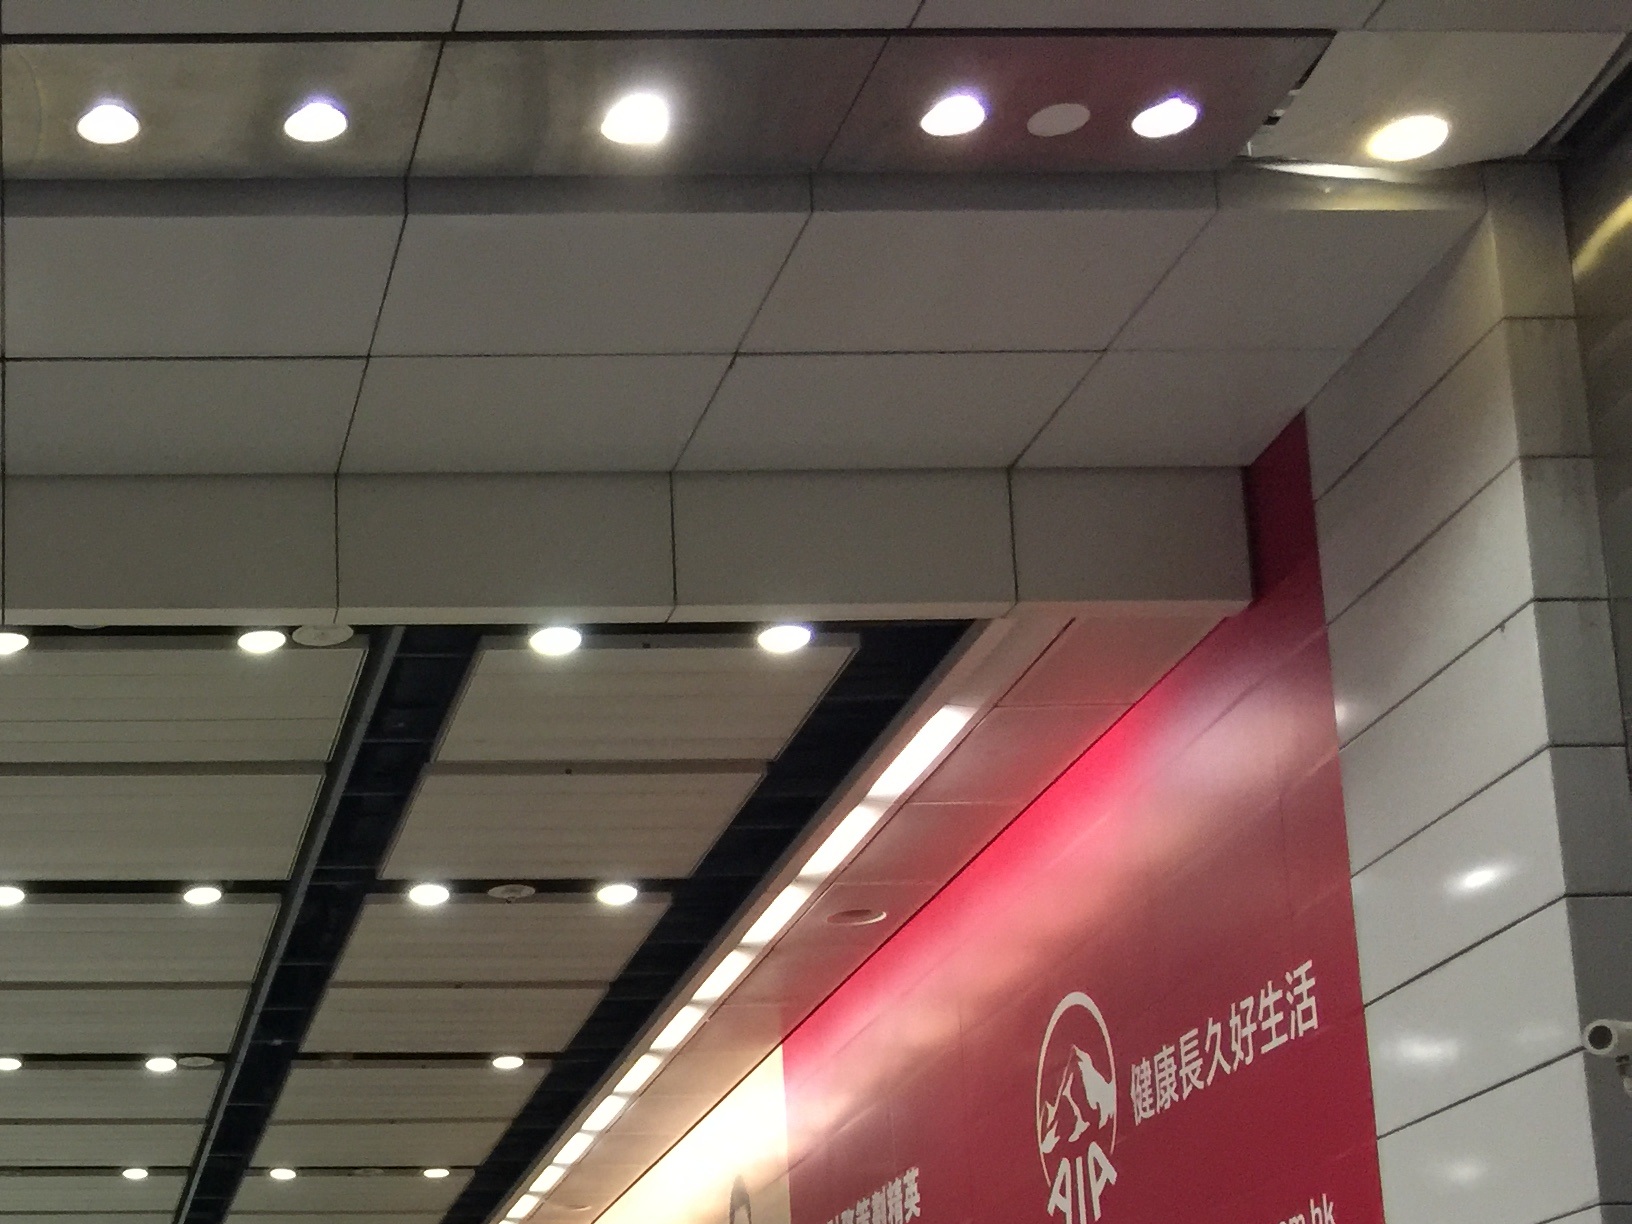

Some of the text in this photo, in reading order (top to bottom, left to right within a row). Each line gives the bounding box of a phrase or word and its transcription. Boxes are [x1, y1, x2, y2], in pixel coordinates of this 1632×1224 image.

[1129, 960, 1318, 1126] 健康長久好生活
